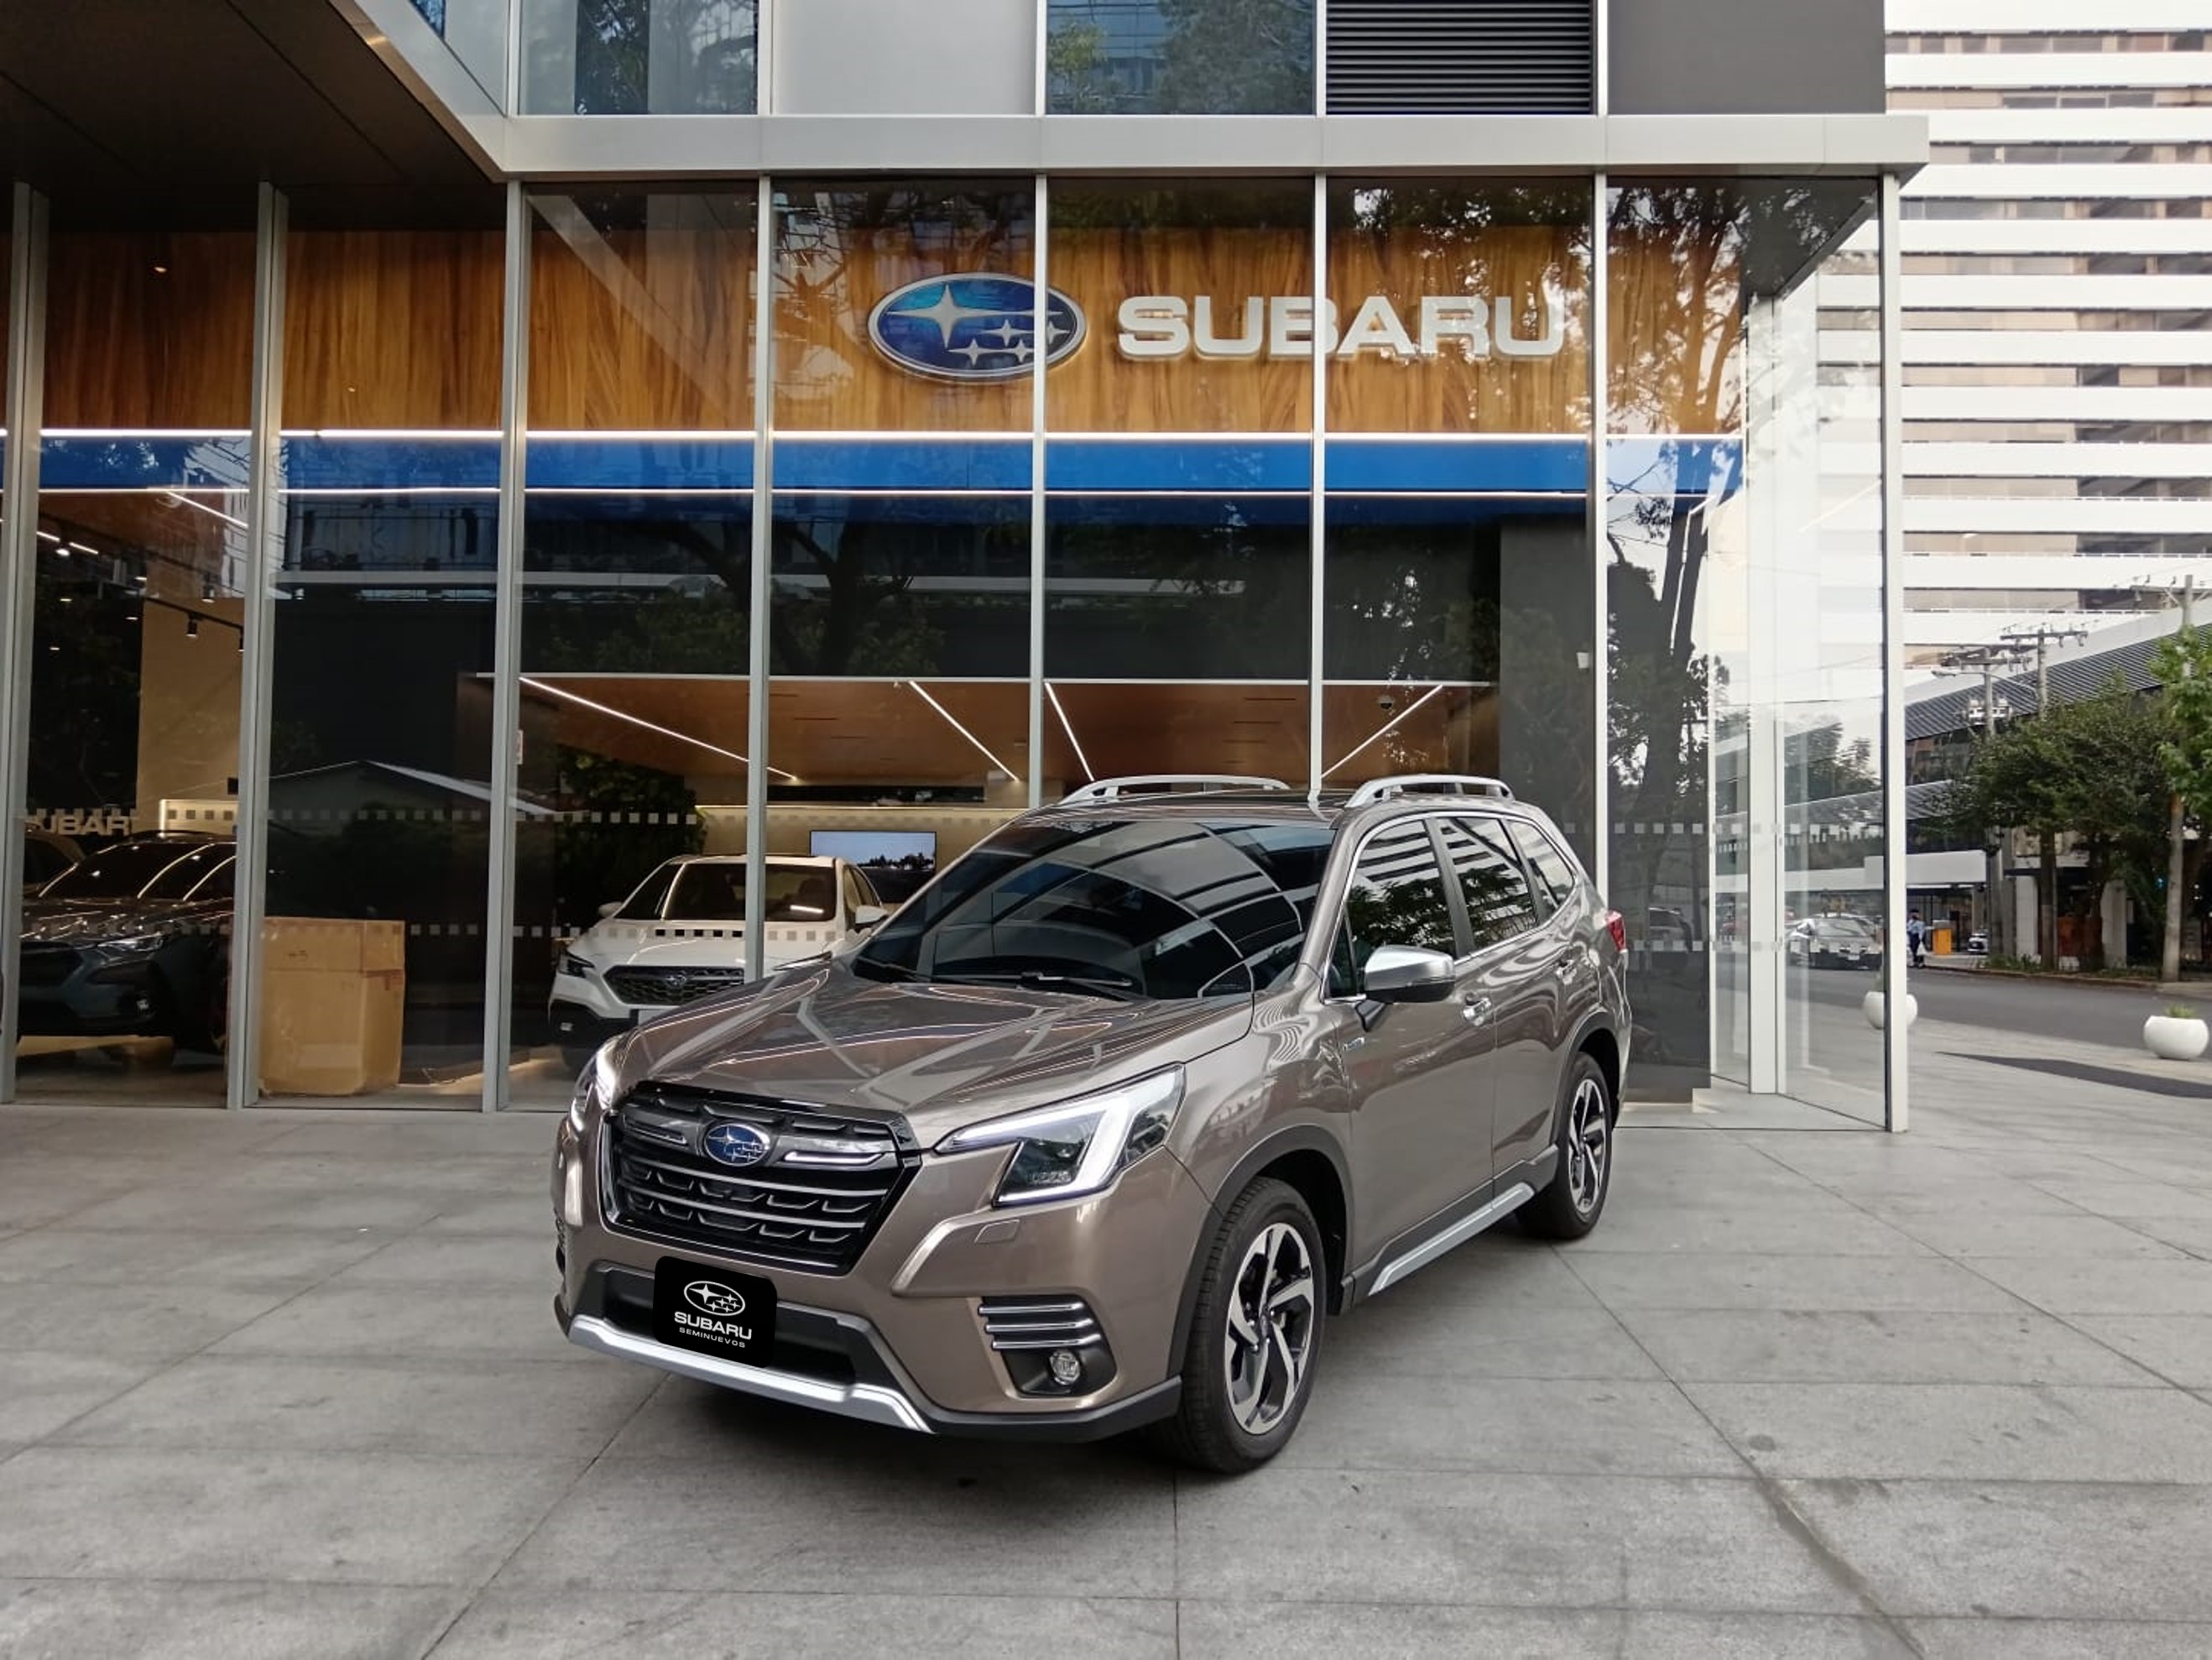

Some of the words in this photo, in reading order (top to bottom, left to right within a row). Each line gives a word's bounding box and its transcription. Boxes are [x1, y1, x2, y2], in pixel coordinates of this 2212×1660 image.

[1118, 295, 1564, 359] SUBARU
[674, 1311, 753, 1340] SUBARU
[679, 1327, 746, 1349] SEMINUEVOS
